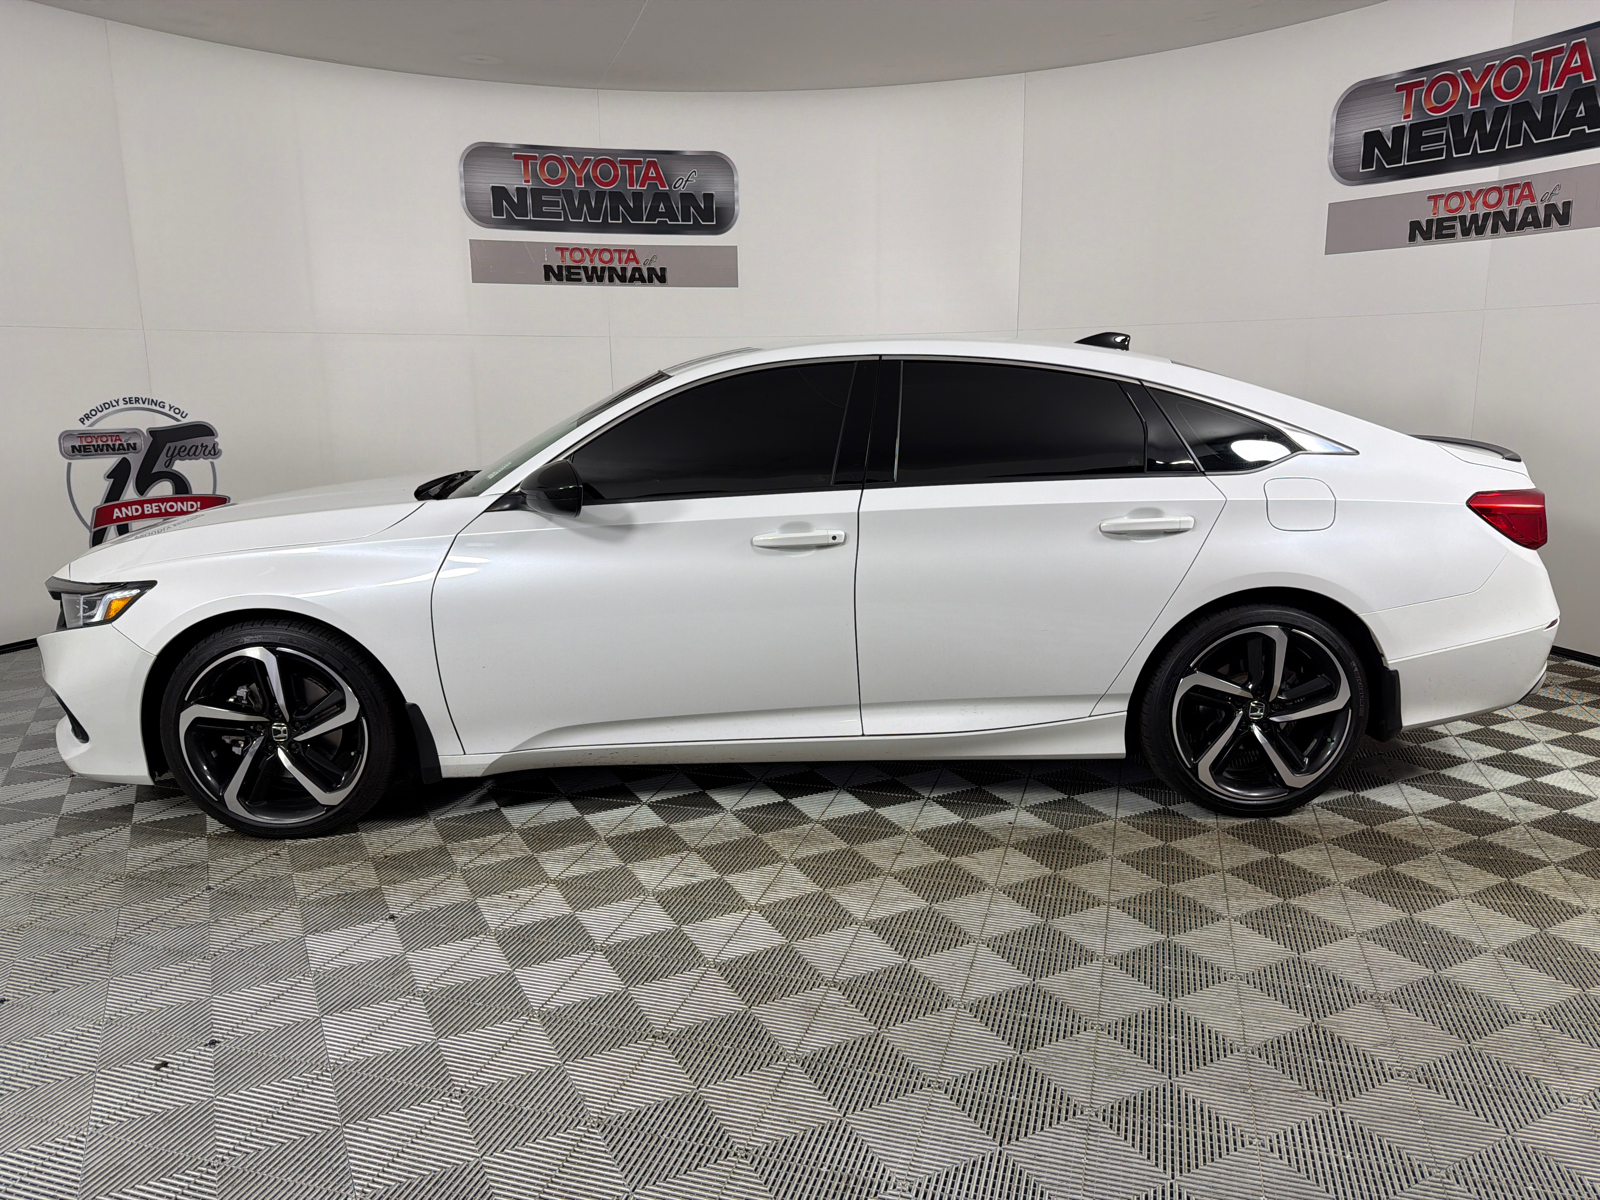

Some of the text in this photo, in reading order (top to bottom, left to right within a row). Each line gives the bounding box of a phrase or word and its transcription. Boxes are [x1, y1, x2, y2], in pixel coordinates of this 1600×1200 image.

[1395, 38, 1597, 121] TOYOTA
[1359, 85, 1600, 172] NEWNA
[512, 152, 697, 190] TOYOTA of
[490, 185, 717, 225] NEWNAN
[1427, 180, 1561, 216] TOYOTA of
[1407, 200, 1573, 243] NEWNAN
[555, 246, 657, 266] TOYOTA of
[543, 264, 668, 284] NEWNAN
[79, 396, 189, 425] PROUDLY SERVING YOU
[71, 443, 137, 454] NEWNAN
[78, 435, 122, 444] TOYOTA
[164, 442, 219, 469] years
[90, 423, 216, 548] 15
[112, 501, 201, 520] AND BEYOND!
